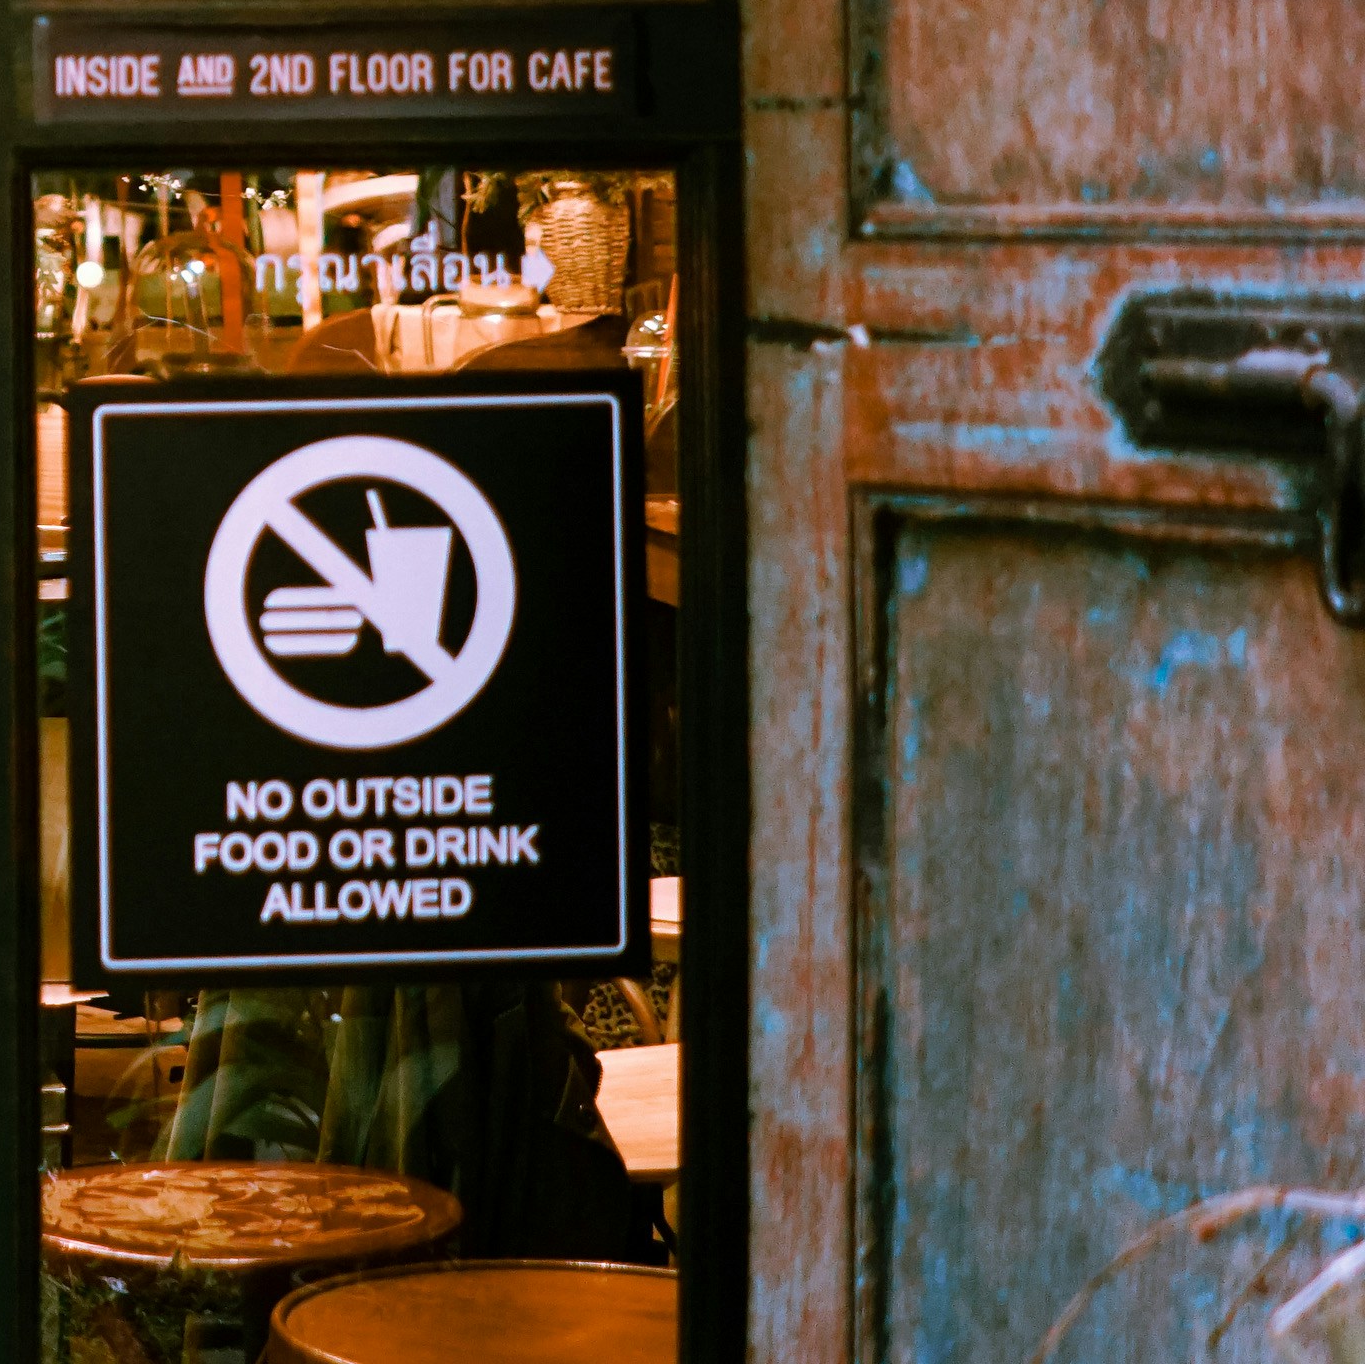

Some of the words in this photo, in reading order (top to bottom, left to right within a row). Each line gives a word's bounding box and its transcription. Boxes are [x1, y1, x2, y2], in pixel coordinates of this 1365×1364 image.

[55, 52, 161, 96] INSIDE
[176, 54, 233, 95] AND
[249, 52, 315, 94] 2ND
[329, 51, 435, 95] FLOOR
[449, 50, 513, 93] FOR
[528, 49, 614, 92] CAFE
[225, 780, 293, 820] NO
[301, 774, 494, 817] OUTSIDE
[194, 831, 319, 873] FOOD
[328, 829, 395, 870] OR
[404, 824, 540, 867] DRINK
[259, 878, 473, 923] ALLOWED
